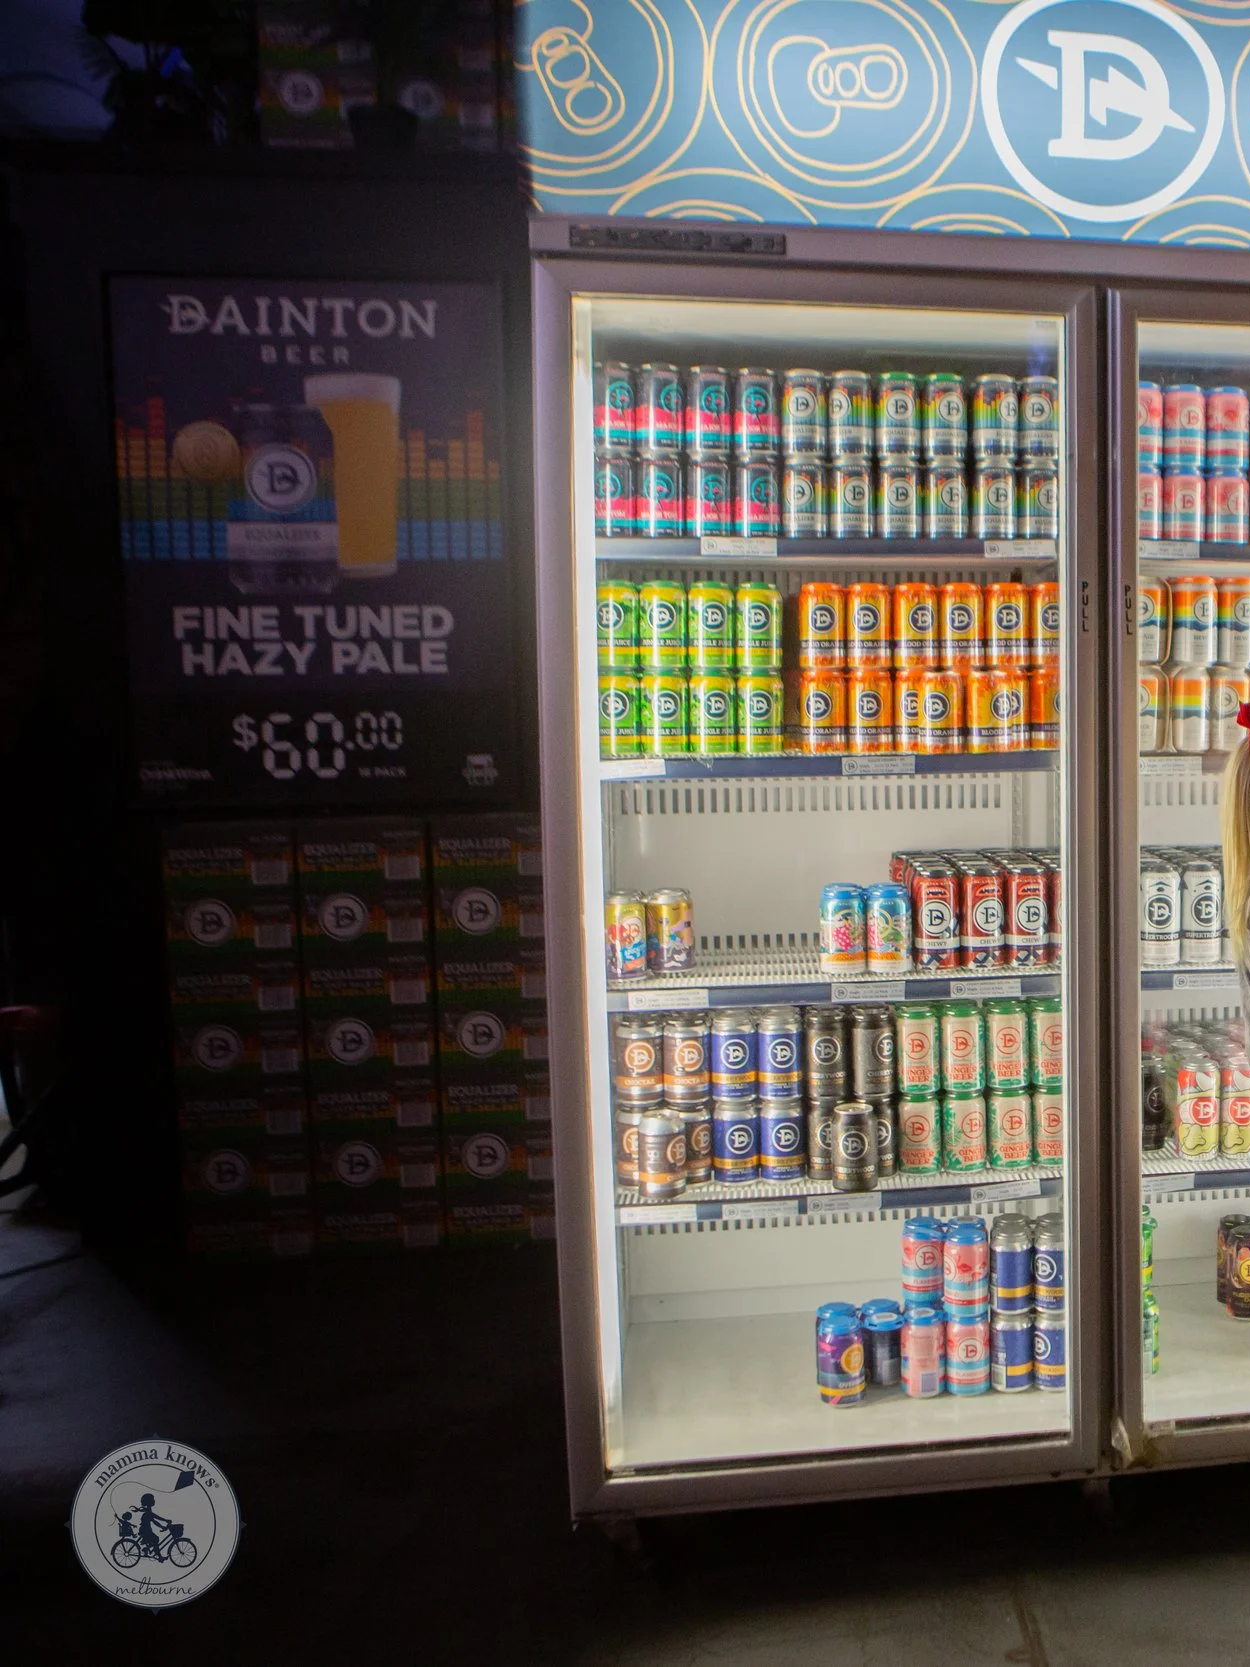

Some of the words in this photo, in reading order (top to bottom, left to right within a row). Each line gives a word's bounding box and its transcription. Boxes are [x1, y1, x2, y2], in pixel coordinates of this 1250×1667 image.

[160, 294, 438, 339] DAINTON
[260, 344, 351, 365] BEER
[173, 605, 280, 640] FINE
[296, 604, 454, 639] TUNED
[1081, 581, 1089, 632] PULL
[1124, 585, 1133, 635] PULL
[181, 641, 318, 677] HAZY
[332, 640, 450, 675] PALE
